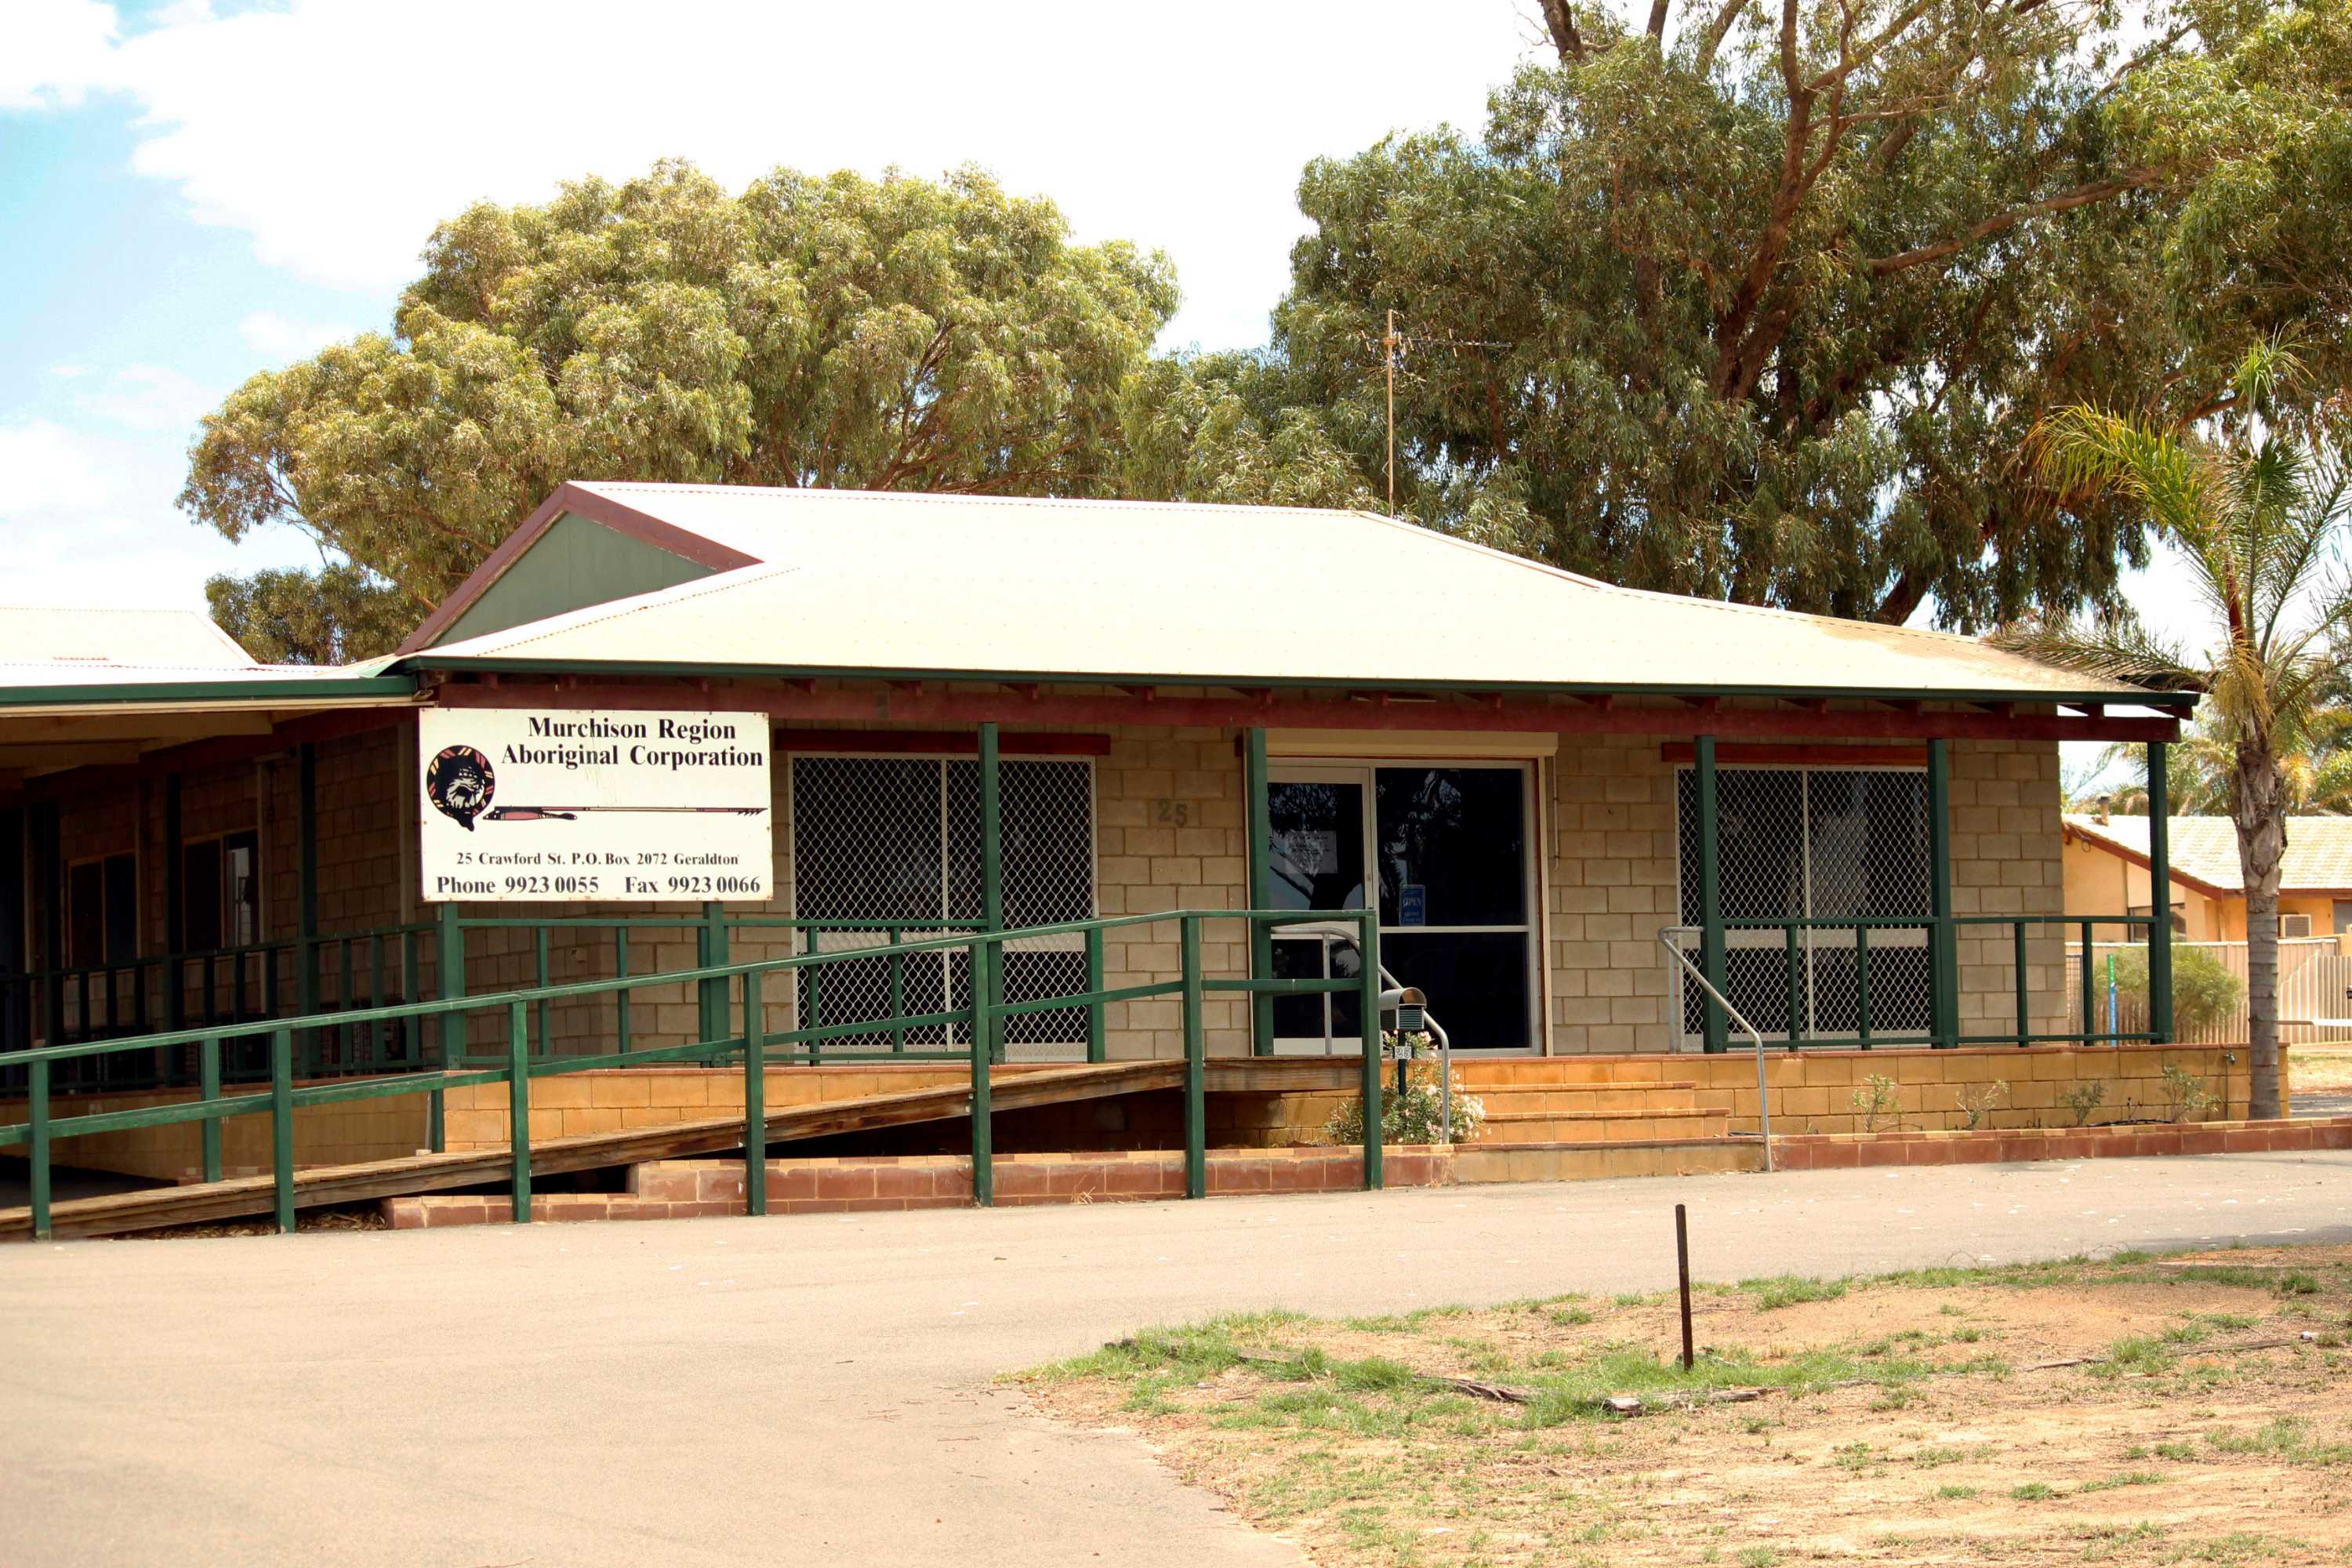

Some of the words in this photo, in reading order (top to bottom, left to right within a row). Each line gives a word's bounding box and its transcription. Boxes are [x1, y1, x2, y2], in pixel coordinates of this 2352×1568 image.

[528, 717, 647, 739] Murchison
[659, 718, 736, 744] Region
[502, 743, 619, 770] Aboriginal
[630, 745, 763, 771] Corporation
[1158, 798, 1188, 828] 25
[456, 852, 473, 865] 25
[479, 852, 542, 865] Crawford
[547, 852, 566, 865] St.
[572, 852, 602, 865] P.O.
[604, 852, 631, 865] Box
[637, 852, 667, 865] 2072
[673, 852, 739, 865] Geraldton
[437, 876, 496, 894] Phone
[505, 876, 550, 894] 9923
[554, 876, 600, 894] 0055
[626, 876, 659, 894] Fax
[668, 876, 712, 894] 9923
[716, 876, 760, 894] 0066
